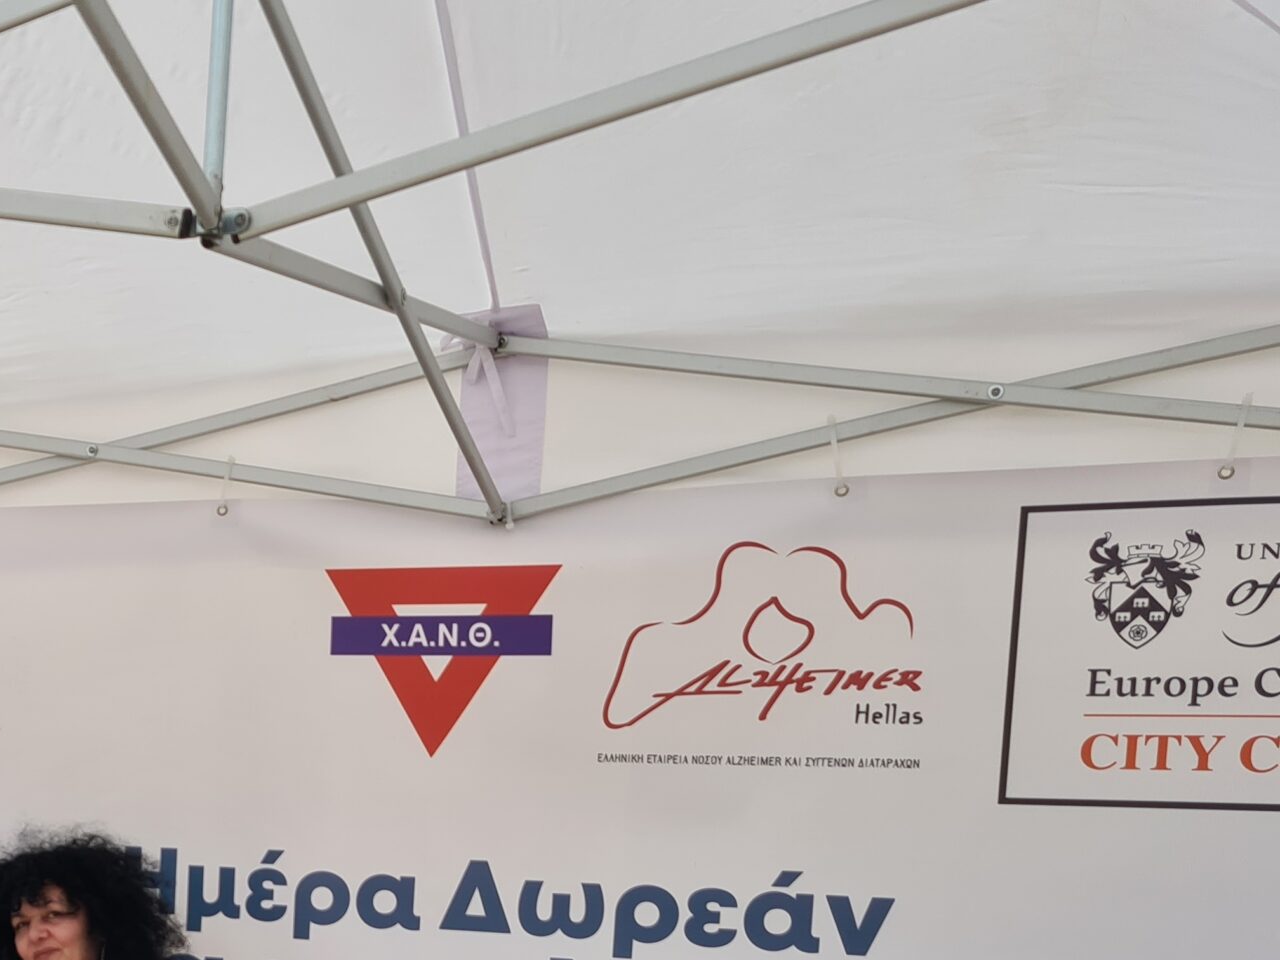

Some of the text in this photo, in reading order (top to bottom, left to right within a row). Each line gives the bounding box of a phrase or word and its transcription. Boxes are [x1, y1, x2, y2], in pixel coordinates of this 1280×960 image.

[380, 623, 500, 649] Χ.Α.Ν.Θ.
[652, 660, 923, 720] ALZHEIMER
[1085, 668, 1240, 707] Europe
[854, 702, 924, 726] Hellas
[597, 752, 921, 769] ΕΛΛΗΝΙΚΗ ΕΤΑΙΡΕΙΑ ΝΟΣΟΥ ALZHEIMER ΚΑΙ ΣΥΓΓΕΝΩΝ ΔΙΑΤΑΡΑΧΩΝ
[1080, 733, 1227, 773] CITY
[438, 859, 896, 958] Δωρεάν
